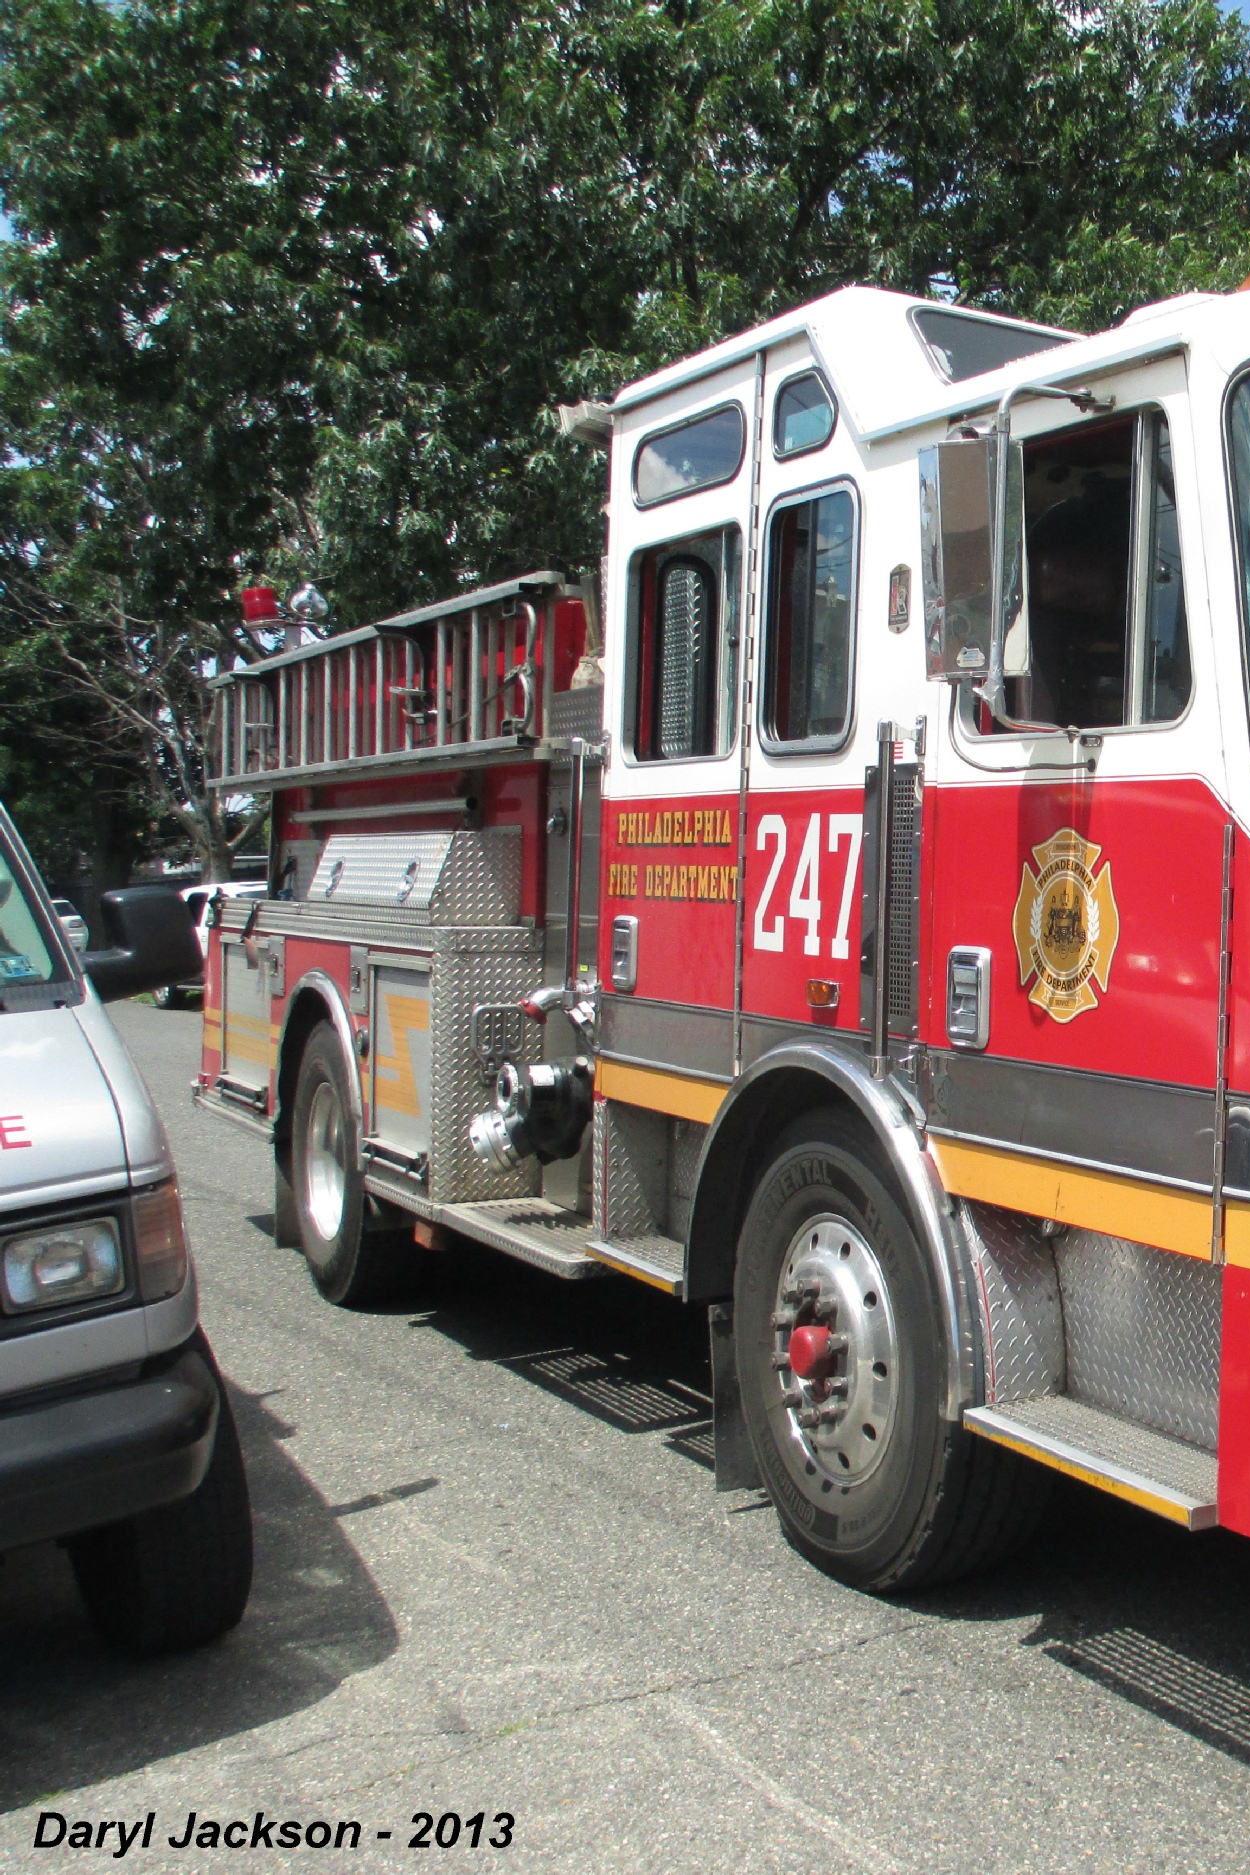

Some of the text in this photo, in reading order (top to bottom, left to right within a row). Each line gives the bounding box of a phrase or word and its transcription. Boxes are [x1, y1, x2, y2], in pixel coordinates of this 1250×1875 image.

[617, 809, 732, 847] PHILADELPHIA
[608, 864, 738, 903] FIRE DEPARTMENT
[753, 812, 863, 960] 247
[1038, 859, 1092, 889] PHILADELPHIA
[1032, 951, 1095, 991] FIRE DEPARTMENT
